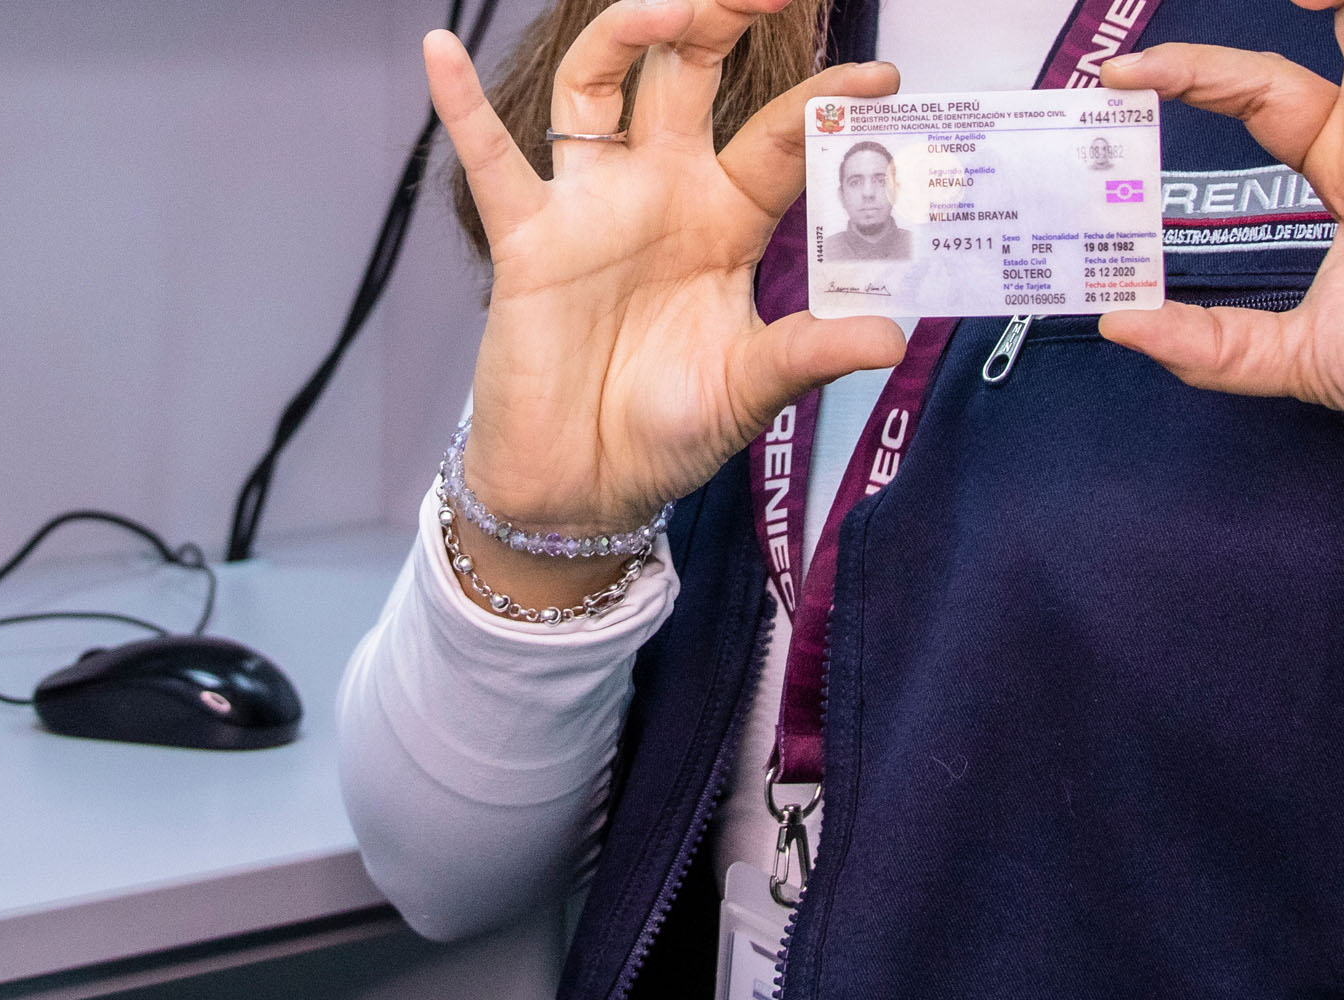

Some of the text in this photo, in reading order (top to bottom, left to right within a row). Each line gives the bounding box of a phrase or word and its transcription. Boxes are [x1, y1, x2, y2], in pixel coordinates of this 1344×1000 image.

[850, 99, 980, 115] REPÚBLICA DEL PERÚ
[851, 116, 889, 124] REGISTRO
[944, 112, 1006, 121] IDENTIFICACIÓN
[1047, 110, 1067, 118] CIVIL
[1080, 109, 1154, 124] 41441372-8
[851, 124, 899, 132] DOCUMENTO
[955, 133, 986, 142] Apellido
[928, 143, 976, 153] OLIVEROS
[928, 167, 996, 176] Segundo Apellido
[928, 177, 974, 188] AREVALO
[1162, 174, 1322, 213] RENIE
[930, 201, 975, 209] Prenombres
[929, 211, 1018, 222] WILLIAMS BRAYAN
[1031, 233, 1079, 241] Nacionalidad
[1116, 231, 1157, 239] Nacimiento
[816, 226, 824, 263] 41441372
[932, 237, 993, 251] 949311
[1002, 243, 1052, 254] M PER
[1084, 241, 1134, 252] 19 08 1982
[1030, 258, 1047, 266] Civil
[1002, 268, 1052, 280] SOLTERO
[1084, 267, 1135, 278] 26 12 2020
[1026, 282, 1051, 291] Tarjeta
[1119, 280, 1158, 288] Caducidad
[1005, 293, 1066, 305] 0200169055
[1085, 291, 1136, 302] 26 12 2028
[764, 404, 797, 612] RENIEC
